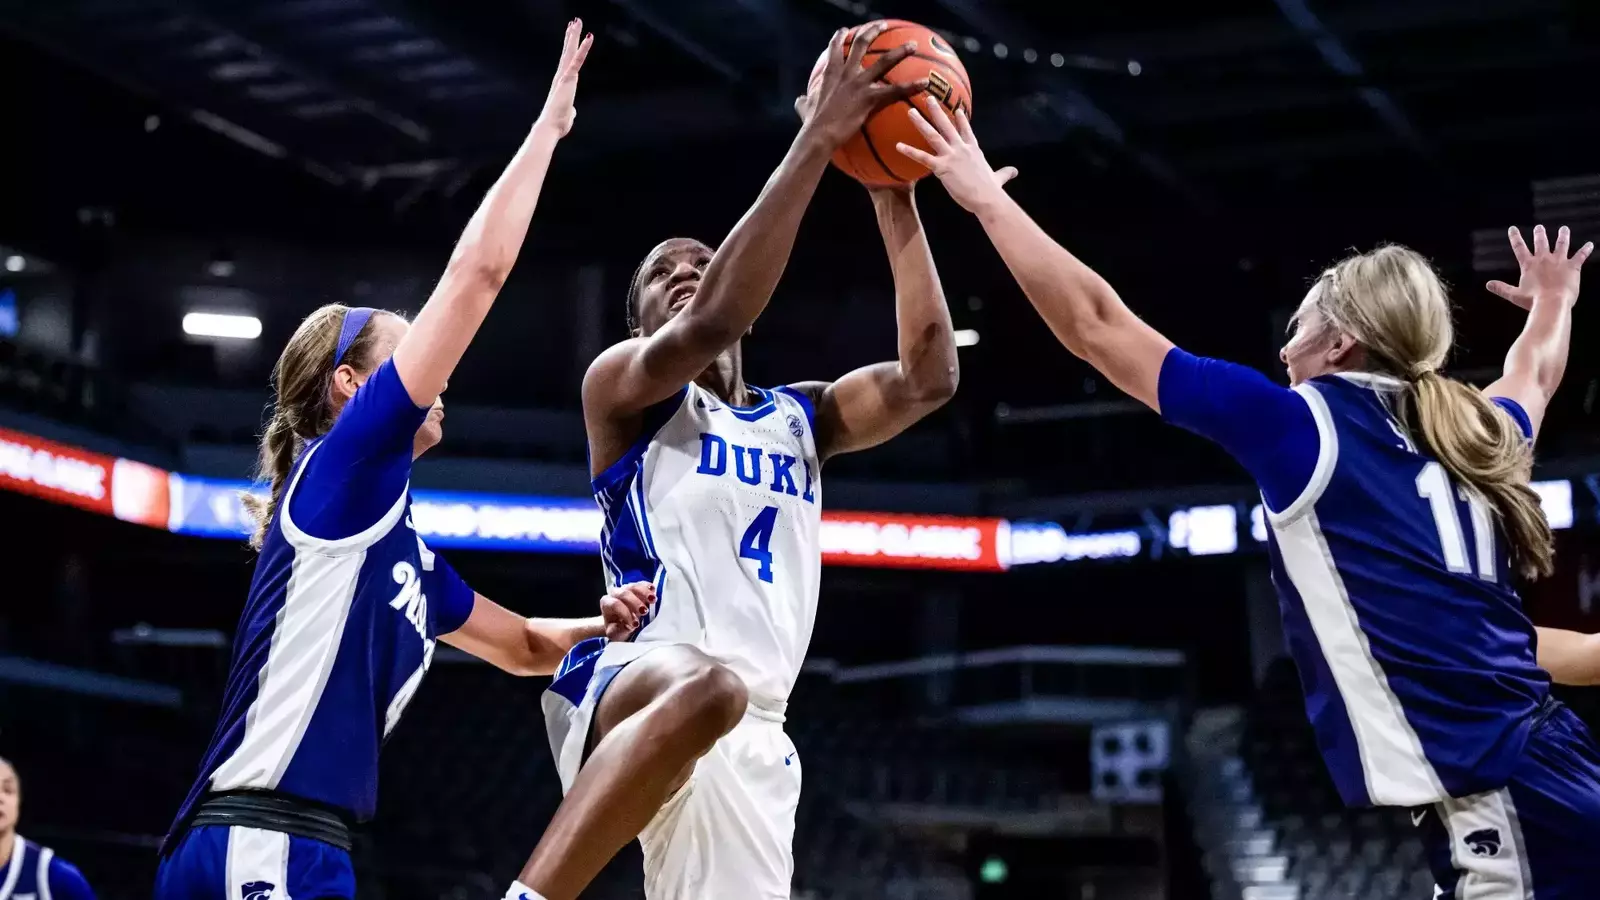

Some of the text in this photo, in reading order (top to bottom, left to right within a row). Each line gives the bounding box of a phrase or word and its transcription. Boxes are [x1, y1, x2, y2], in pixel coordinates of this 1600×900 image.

[697, 432, 815, 504] DUKE
[739, 506, 778, 583] 4
[1415, 461, 1498, 583] 11
